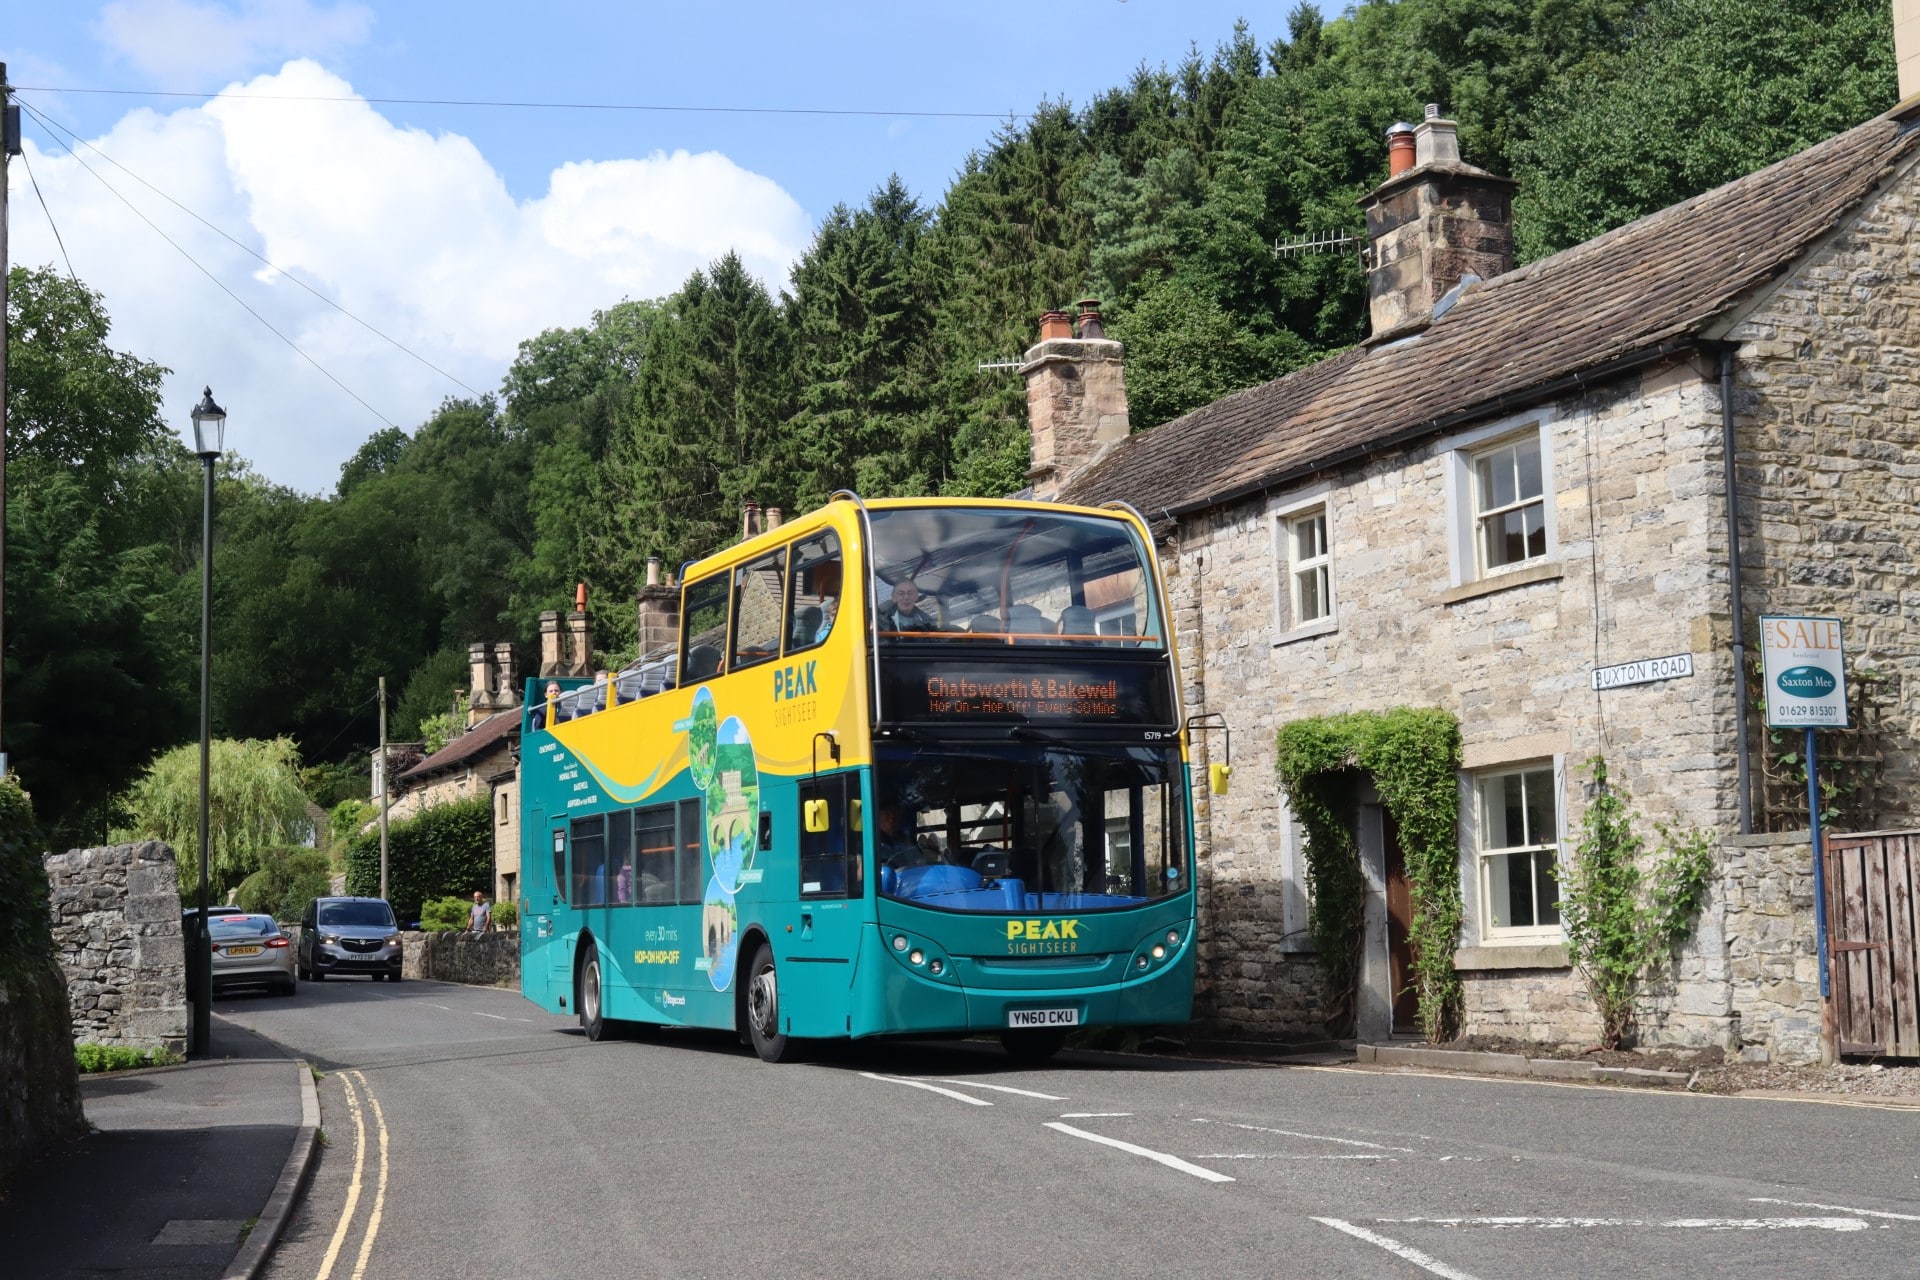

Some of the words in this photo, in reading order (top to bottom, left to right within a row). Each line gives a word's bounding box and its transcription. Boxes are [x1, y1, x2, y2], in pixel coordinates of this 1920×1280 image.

[1766, 621, 1774, 648] FOR
[1776, 620, 1840, 650] SALE
[774, 660, 817, 702] PEAK
[1595, 663, 1646, 686] BUXTON
[1652, 657, 1686, 677] ROAD
[1782, 675, 1813, 687] Saxton
[1815, 676, 1833, 688] Mee
[927, 677, 1028, 698] Chatsworth
[1031, 678, 1044, 699] &
[1047, 679, 1117, 700] Bakewell
[775, 700, 817, 728] SIGHTSEER
[930, 700, 952, 713] Hop
[955, 700, 969, 713] On
[982, 701, 1004, 713] Hop
[1037, 701, 1073, 714] Every
[1076, 702, 1091, 714] 30
[1093, 701, 1117, 714] Mins
[1779, 705, 1807, 716] 01629
[1809, 706, 1837, 716] 815307
[1144, 732, 1161, 740] 15719
[645, 930, 657, 946] every
[657, 926, 665, 941] 30
[665, 925, 678, 941] mins
[1007, 920, 1078, 940] PEAK
[635, 950, 655, 964] HOP-ON
[655, 950, 680, 964] HOP-OFF
[1008, 942, 1077, 954] SIGHTSEER
[1014, 1011, 1046, 1025] YN60
[1049, 1010, 1073, 1023] CKU
